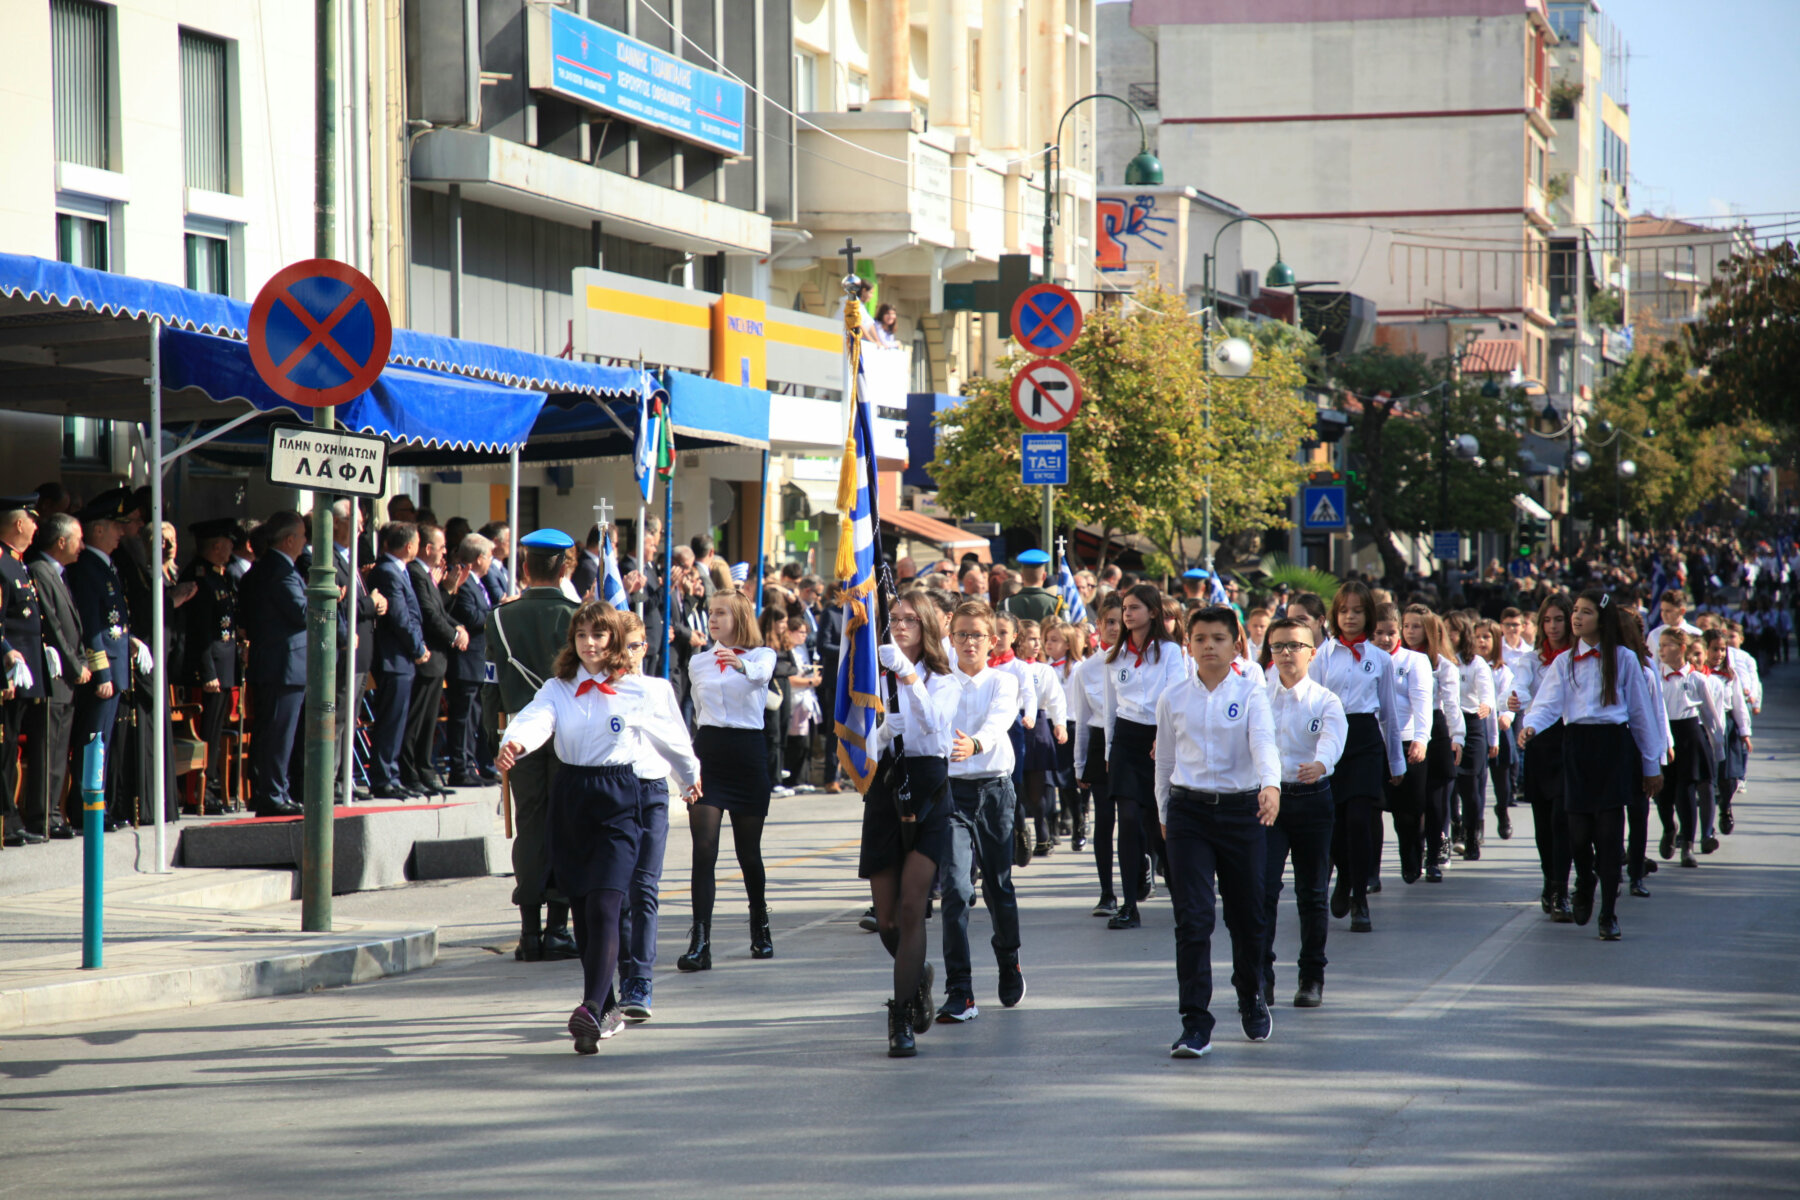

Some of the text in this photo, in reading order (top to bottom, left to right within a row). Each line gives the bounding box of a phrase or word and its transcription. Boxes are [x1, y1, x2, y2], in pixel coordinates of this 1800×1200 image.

[279, 438, 377, 460] ΠΛΗΝ ΟΧΗΜΑΤΩΝ
[1028, 456, 1061, 469] ΤΑΞΙ
[1365, 661, 1372, 672] 6
[1121, 669, 1127, 681] 6
[1228, 702, 1240, 718] 6
[610, 717, 621, 733] 6
[1310, 719, 1320, 732] 6
